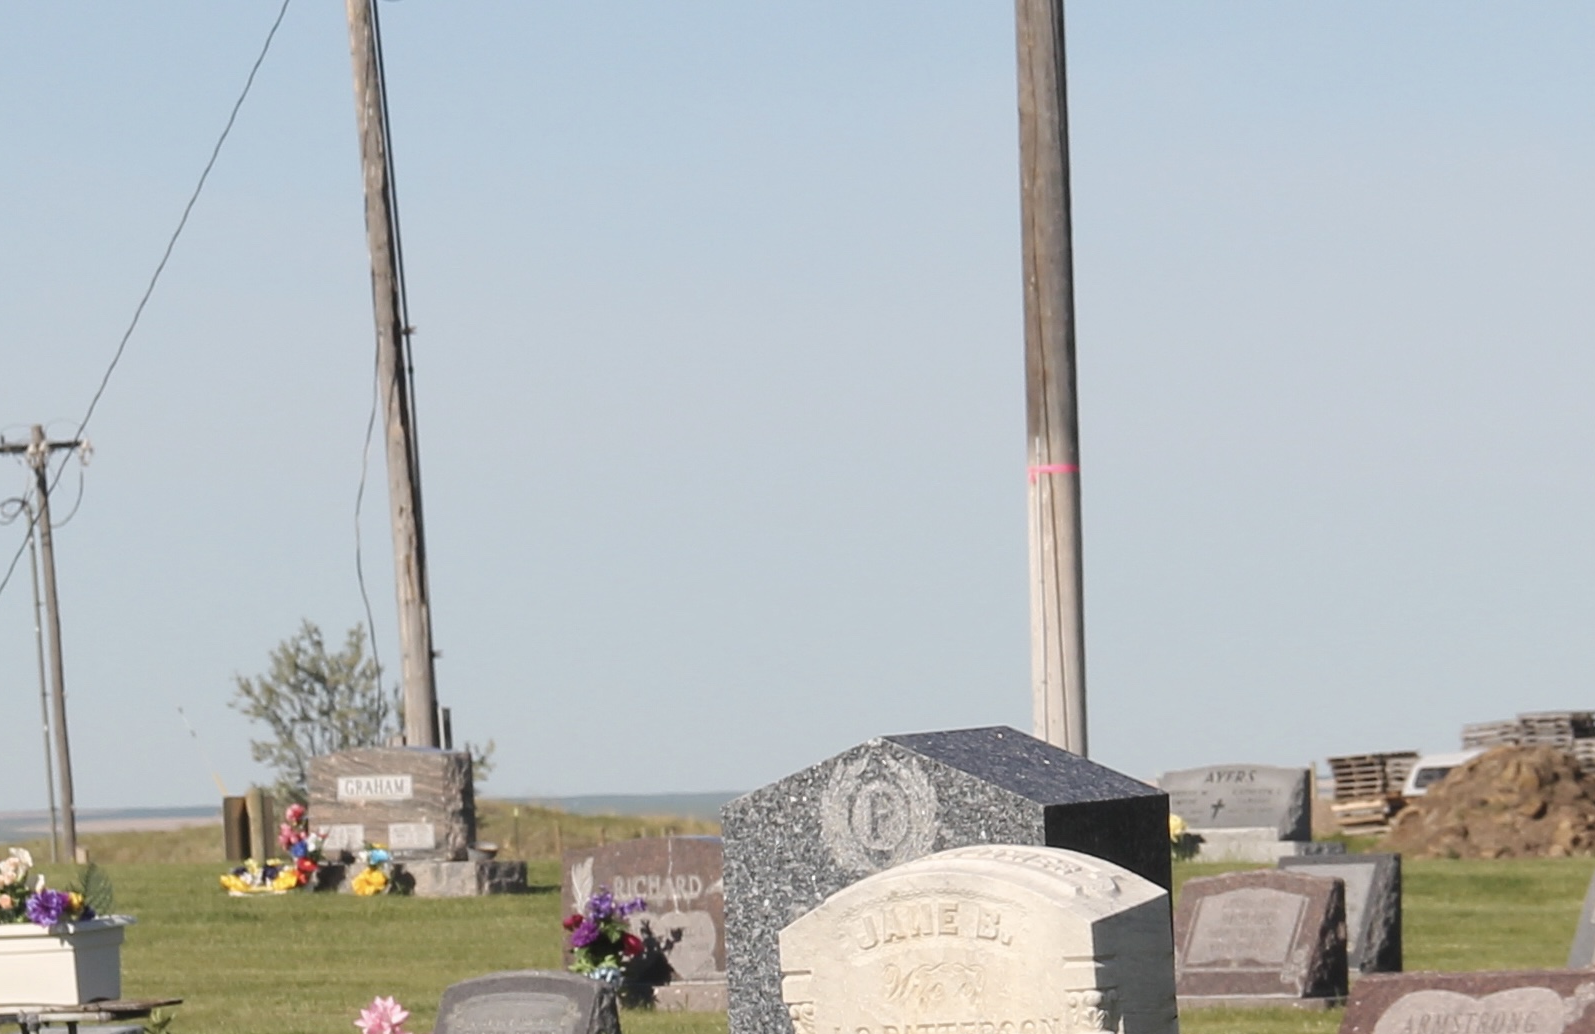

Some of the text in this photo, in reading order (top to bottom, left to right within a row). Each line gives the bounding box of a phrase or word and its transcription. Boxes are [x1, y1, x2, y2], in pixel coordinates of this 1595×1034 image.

[344, 778, 404, 796] GRAHAM
[872, 790, 897, 841] P
[612, 874, 703, 900] RICHARD
[856, 901, 1014, 951] JANE B.
